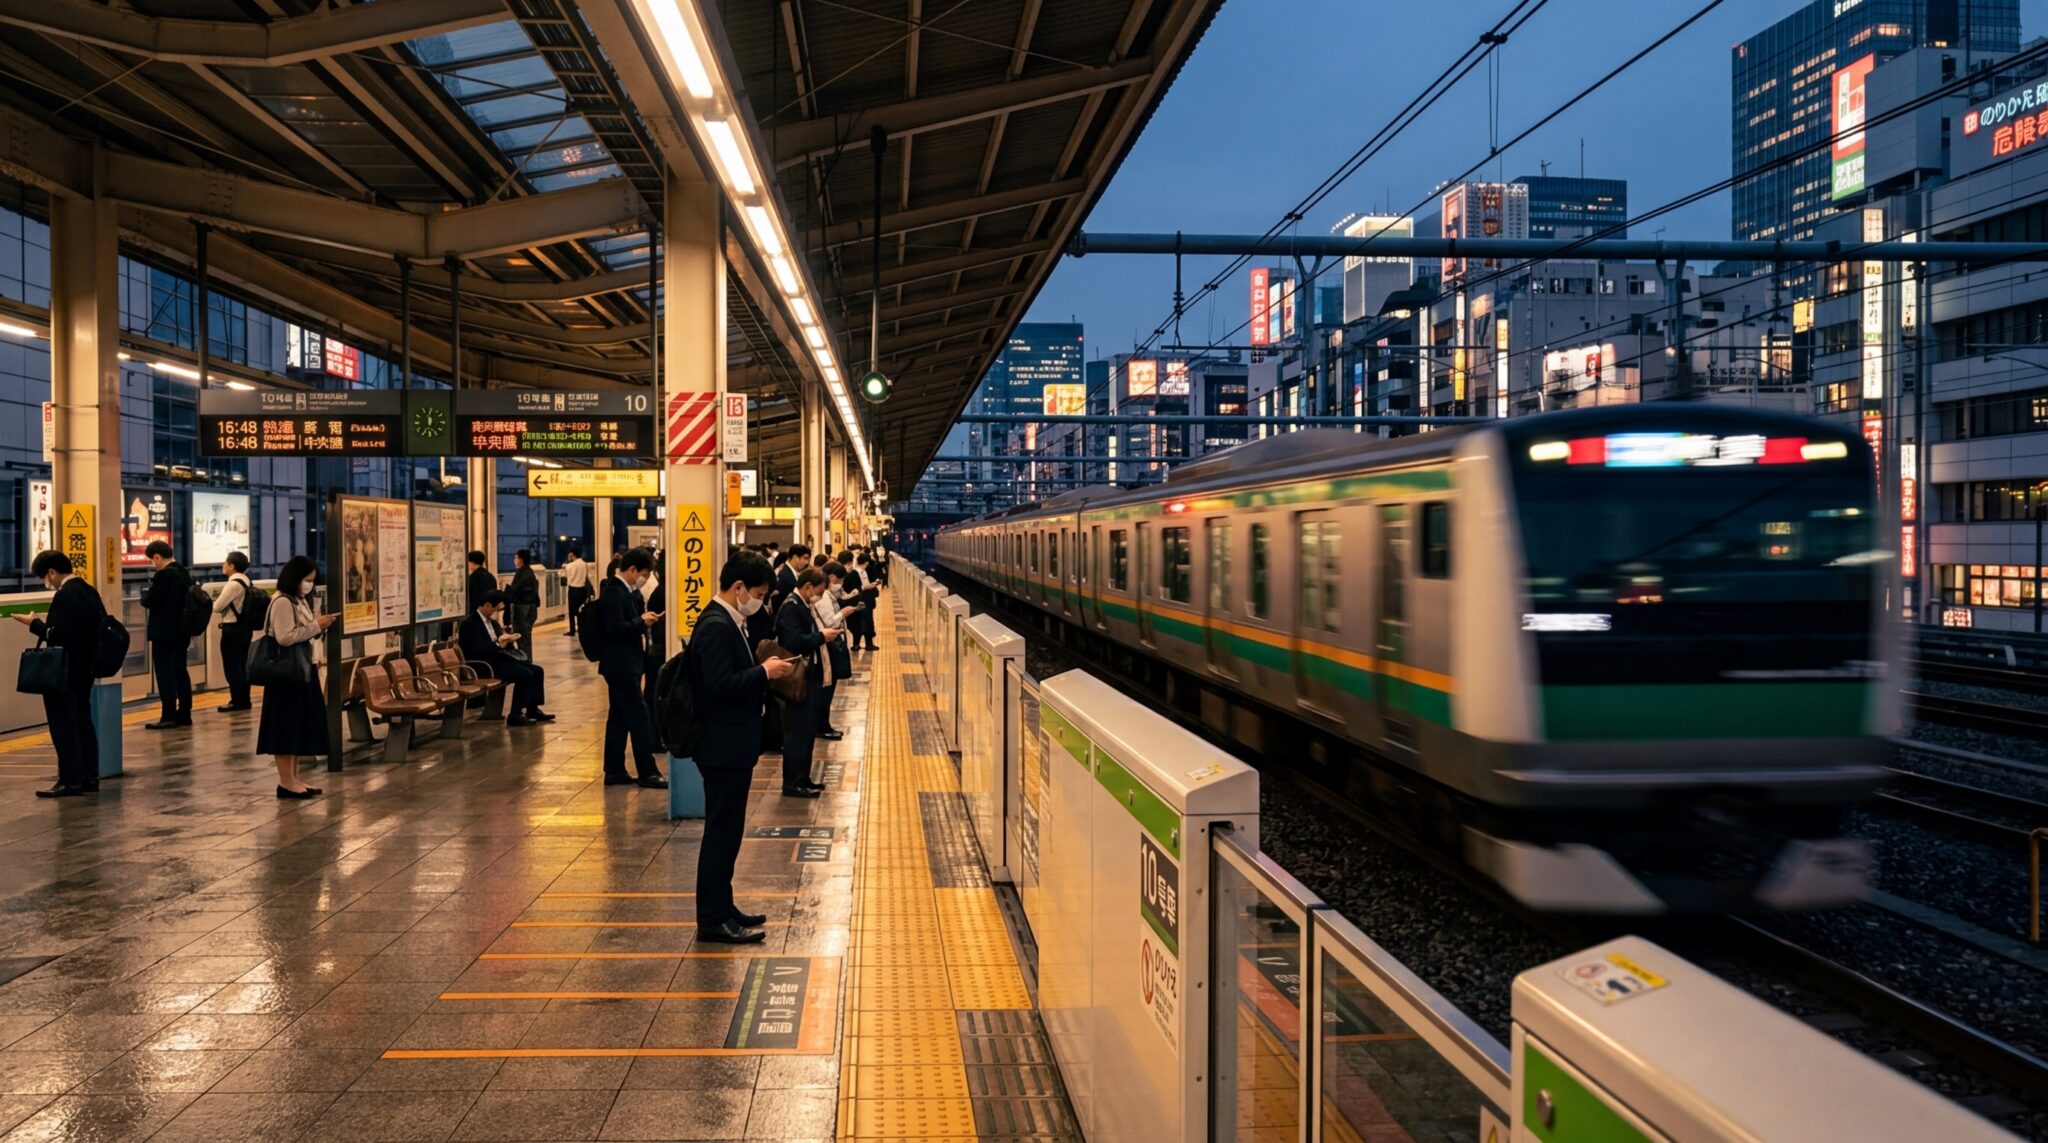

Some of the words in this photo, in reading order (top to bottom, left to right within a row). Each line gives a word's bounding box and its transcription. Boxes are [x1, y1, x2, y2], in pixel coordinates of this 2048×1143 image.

[624, 394, 647, 412] 10
[218, 421, 257, 434] 16:48
[218, 436, 258, 449] 16:48
